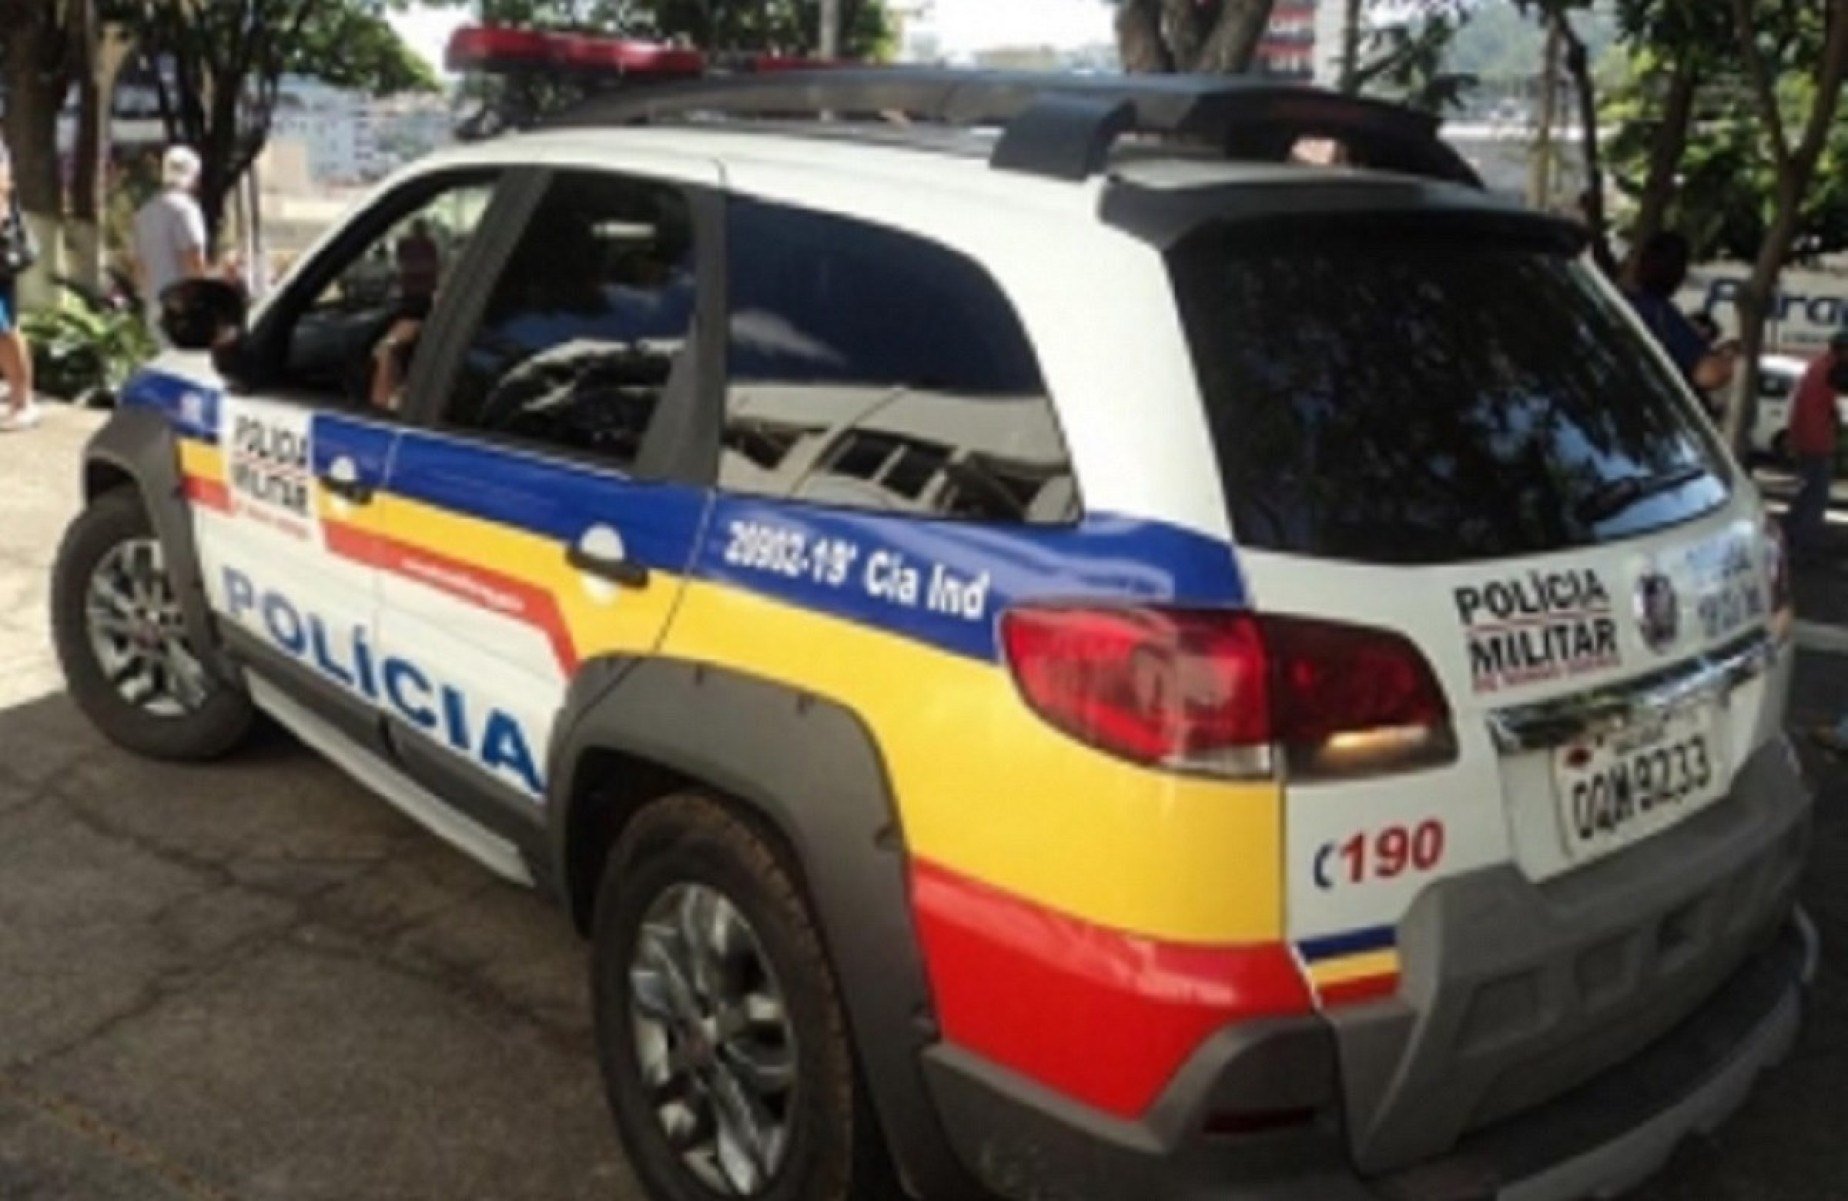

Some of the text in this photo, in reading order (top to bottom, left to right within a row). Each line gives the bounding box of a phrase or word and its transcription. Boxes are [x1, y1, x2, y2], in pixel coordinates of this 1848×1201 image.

[865, 550, 919, 607] Cia
[926, 562, 992, 621] Ind
[1453, 567, 1611, 626] POLÍCIA
[1468, 617, 1619, 675] MILITAR
[221, 566, 547, 793] POLÍCIA
